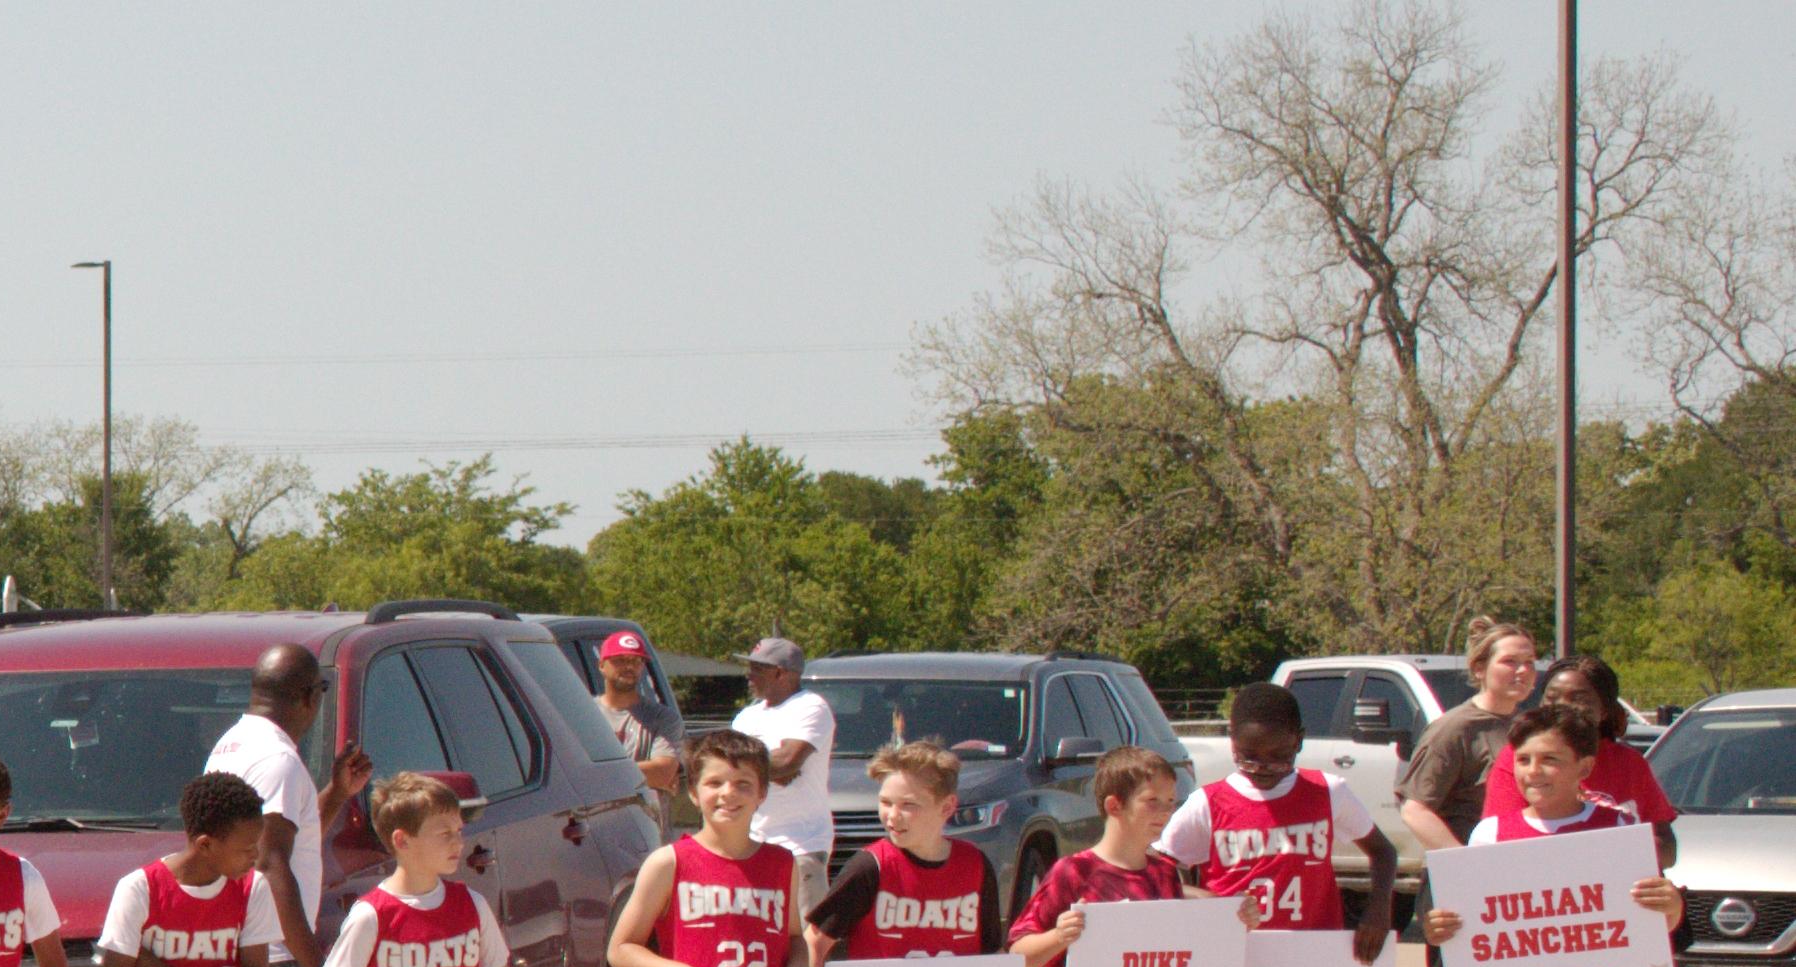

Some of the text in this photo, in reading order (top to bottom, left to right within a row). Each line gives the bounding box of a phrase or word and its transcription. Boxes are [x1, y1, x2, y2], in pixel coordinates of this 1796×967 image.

[1213, 819, 1329, 868] GOATS
[678, 881, 786, 932] GOATS
[875, 889, 980, 934] GOATS
[1248, 875, 1303, 922] 34
[1481, 884, 1604, 926] JULIAN
[142, 924, 240, 961] GOAT
[1472, 918, 1628, 961] SANCHEZ
